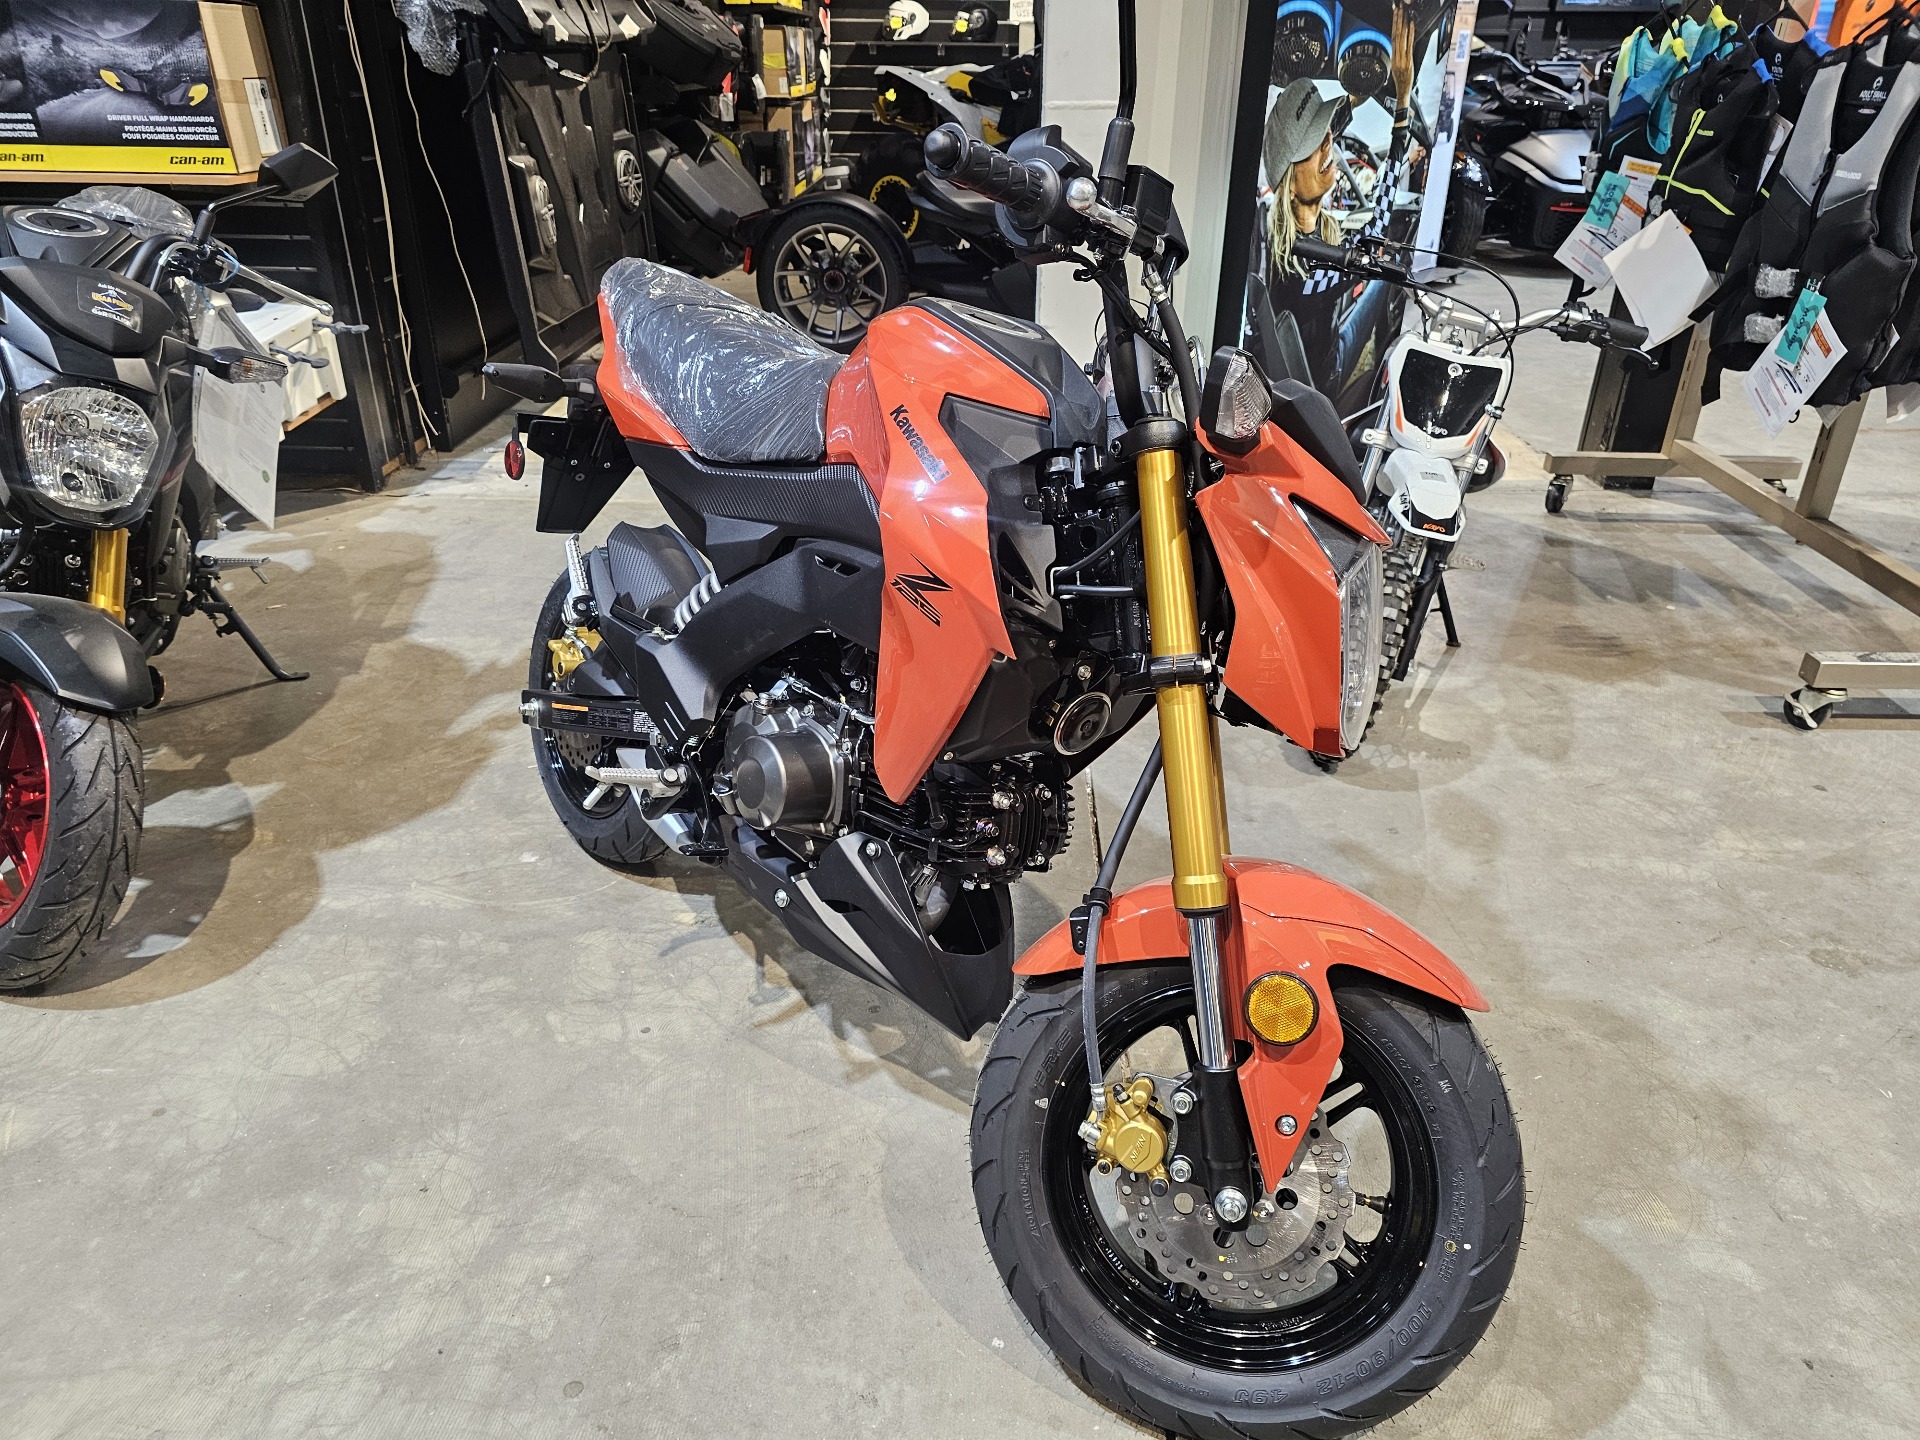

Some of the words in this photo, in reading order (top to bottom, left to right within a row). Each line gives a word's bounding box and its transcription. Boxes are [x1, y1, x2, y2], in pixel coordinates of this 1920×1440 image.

[0, 130, 39, 139] ONDUCTEUR
[0, 153, 44, 162] an-am
[1787, 307, 1810, 350] AIRFLOW
[889, 403, 950, 484] Kawasaki
[1316, 1301, 1433, 1395] 100/90-12
[1234, 1389, 1289, 1405] 49J
